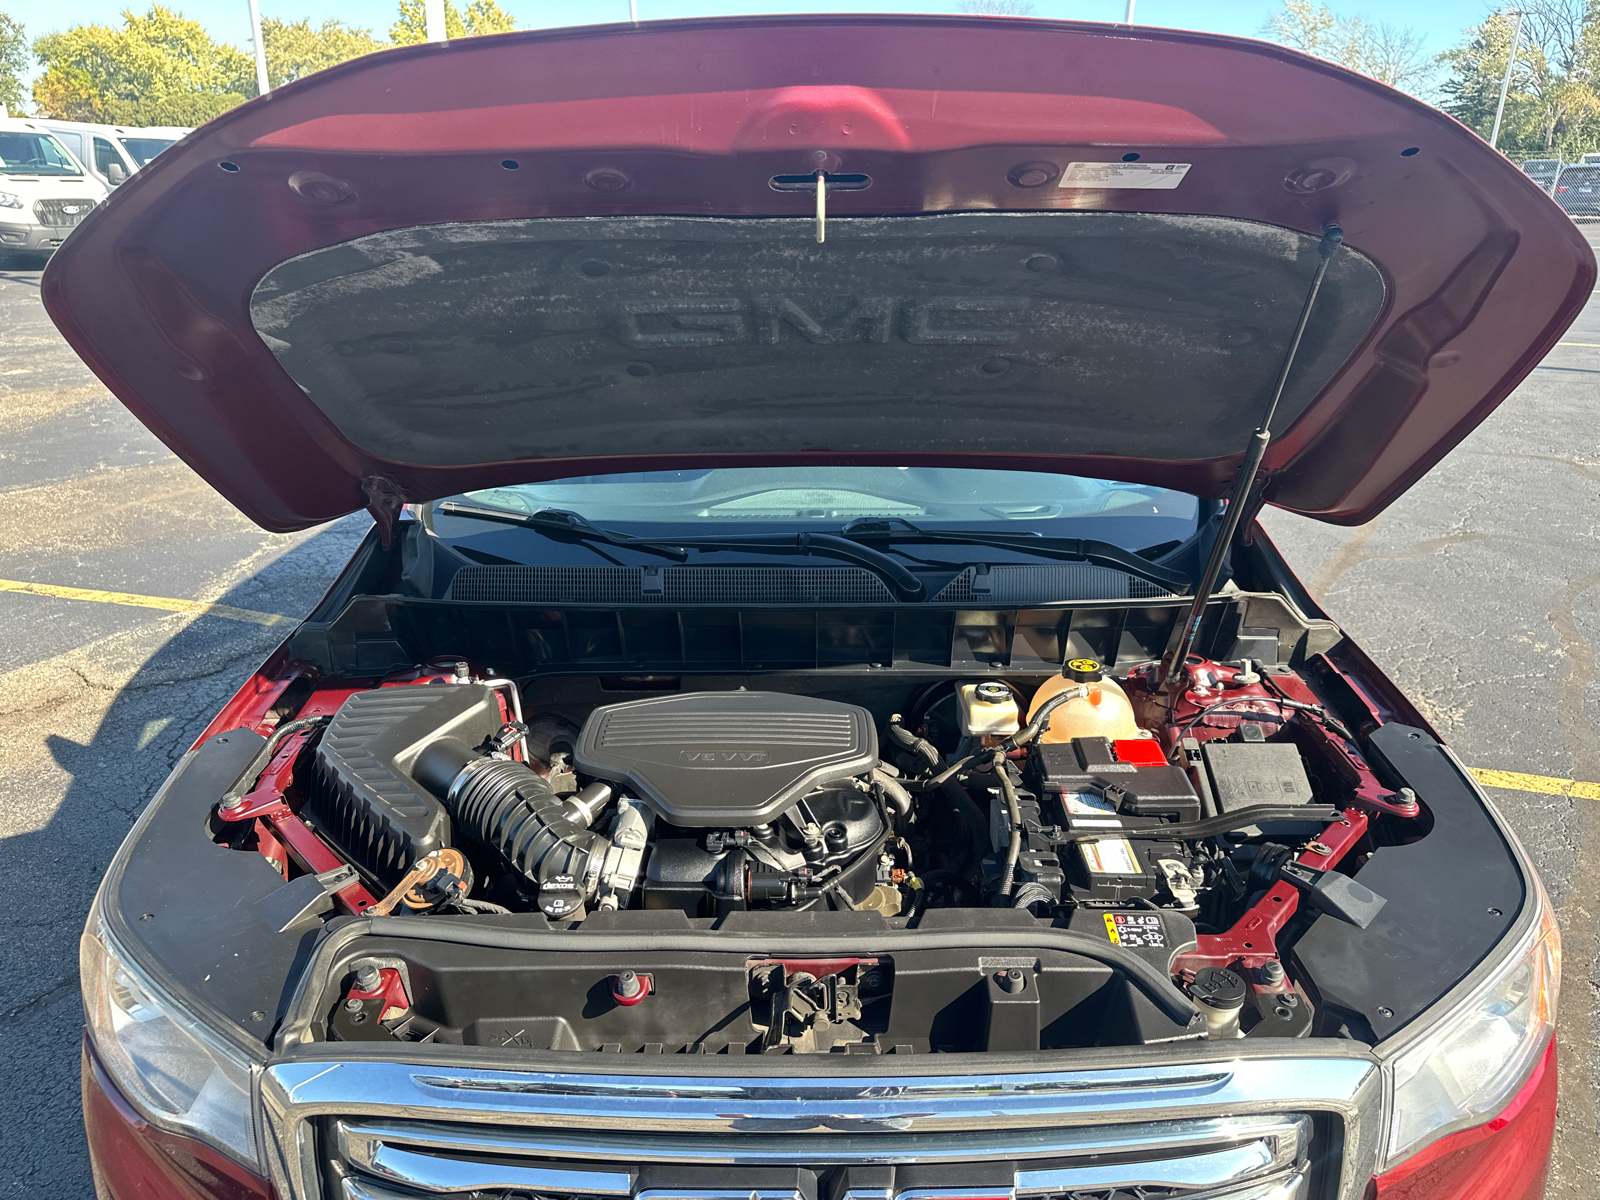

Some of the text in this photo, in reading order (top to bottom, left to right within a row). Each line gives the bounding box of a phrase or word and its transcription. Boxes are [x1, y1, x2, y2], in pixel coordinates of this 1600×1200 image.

[620, 296, 1029, 347] GMC
[683, 752, 767, 762] V6 VVT
[542, 882, 575, 890] dexos
